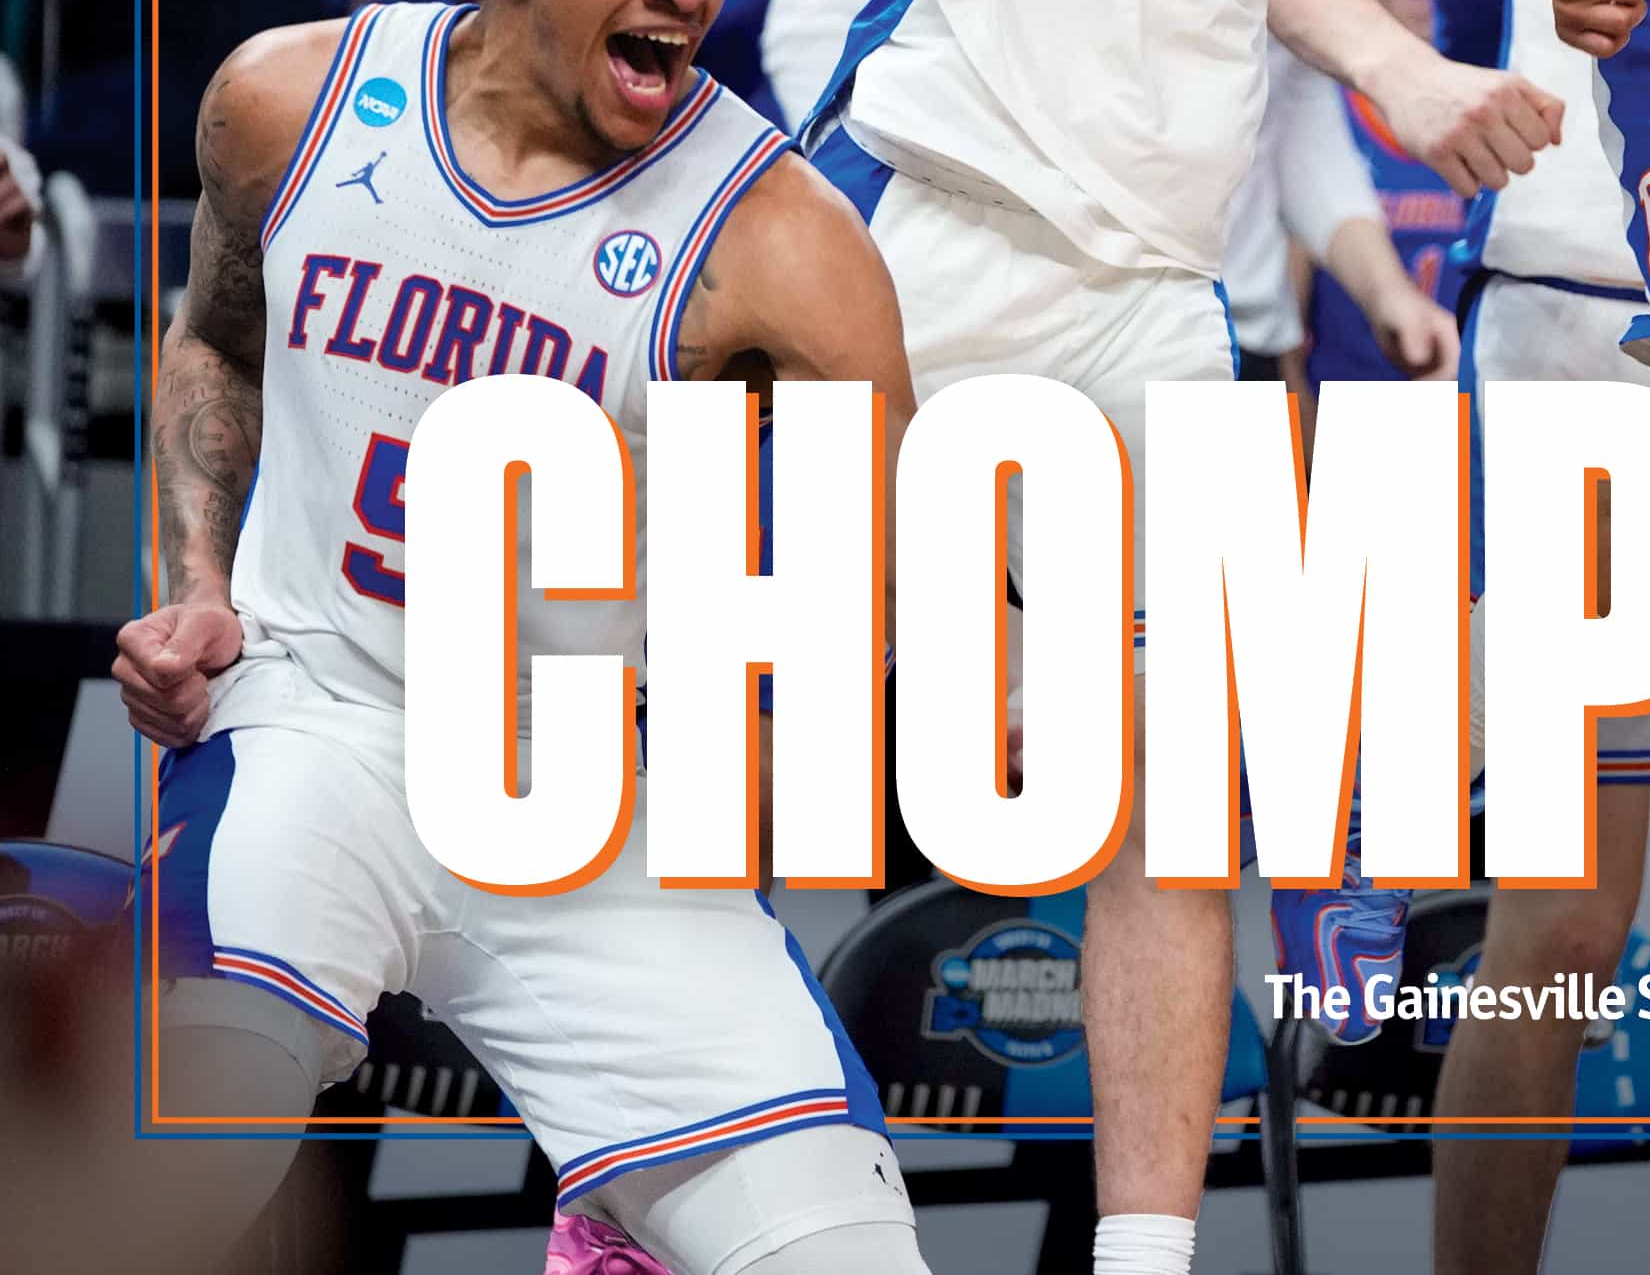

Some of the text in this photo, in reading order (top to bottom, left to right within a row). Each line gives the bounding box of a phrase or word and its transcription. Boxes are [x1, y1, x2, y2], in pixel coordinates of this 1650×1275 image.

[597, 232, 659, 294] SEC
[342, 432, 404, 609] 5
[968, 958, 1077, 990] MARCH
